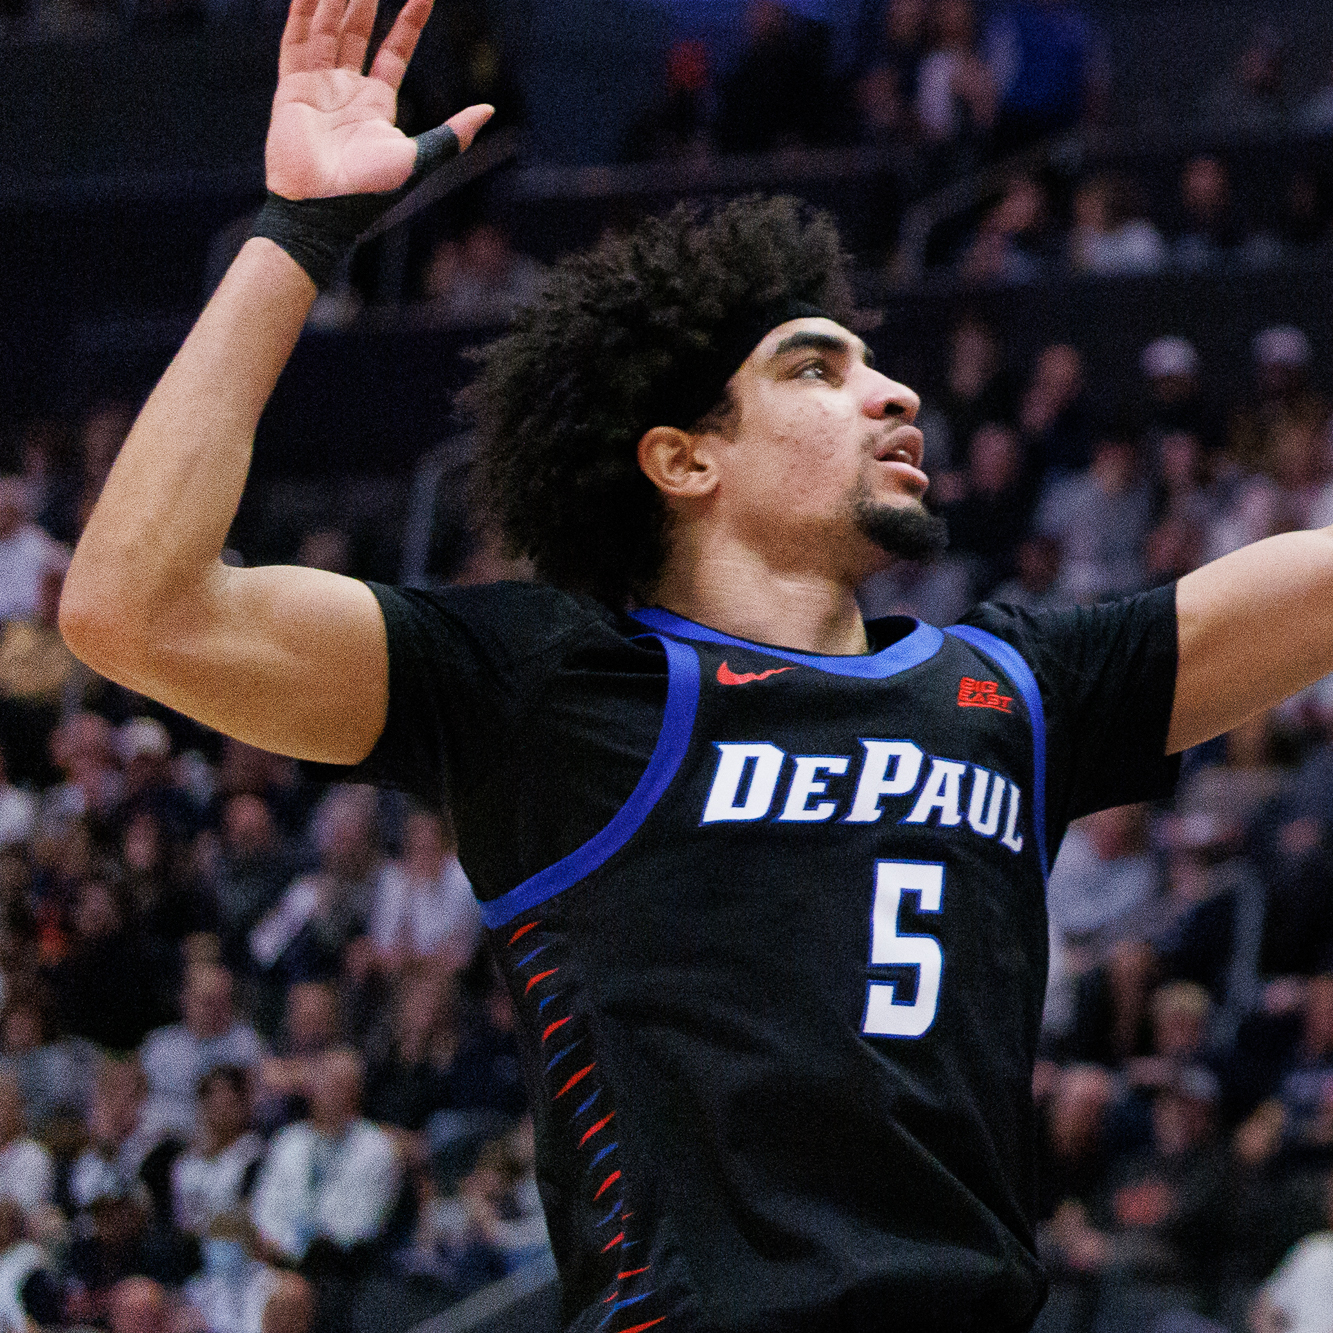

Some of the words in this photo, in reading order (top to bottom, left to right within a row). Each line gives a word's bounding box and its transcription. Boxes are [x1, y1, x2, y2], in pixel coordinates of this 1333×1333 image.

[959, 676, 999, 694] BIG
[957, 689, 1013, 709] EAST
[859, 858, 947, 1041] 5
